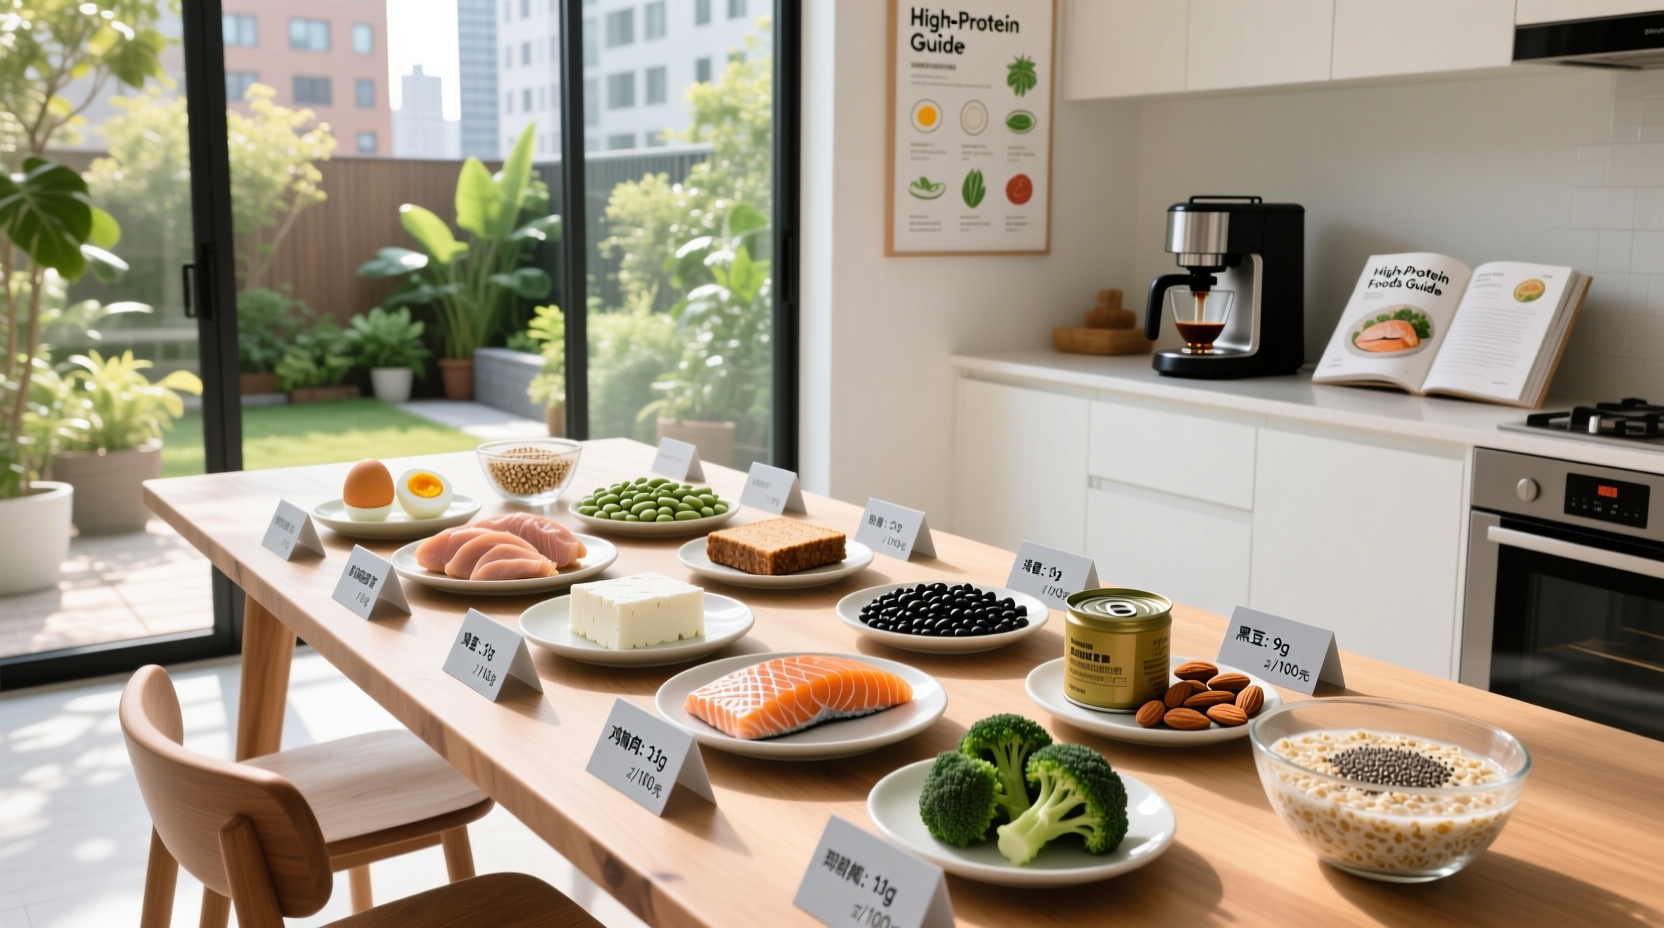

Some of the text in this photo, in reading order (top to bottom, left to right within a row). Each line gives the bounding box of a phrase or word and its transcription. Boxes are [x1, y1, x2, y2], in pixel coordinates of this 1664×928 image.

[911, 7, 1020, 33] High-Protein
[910, 33, 965, 54] Guide
[1406, 279, 1442, 296] Guide
[1273, 637, 1290, 657] 9g
